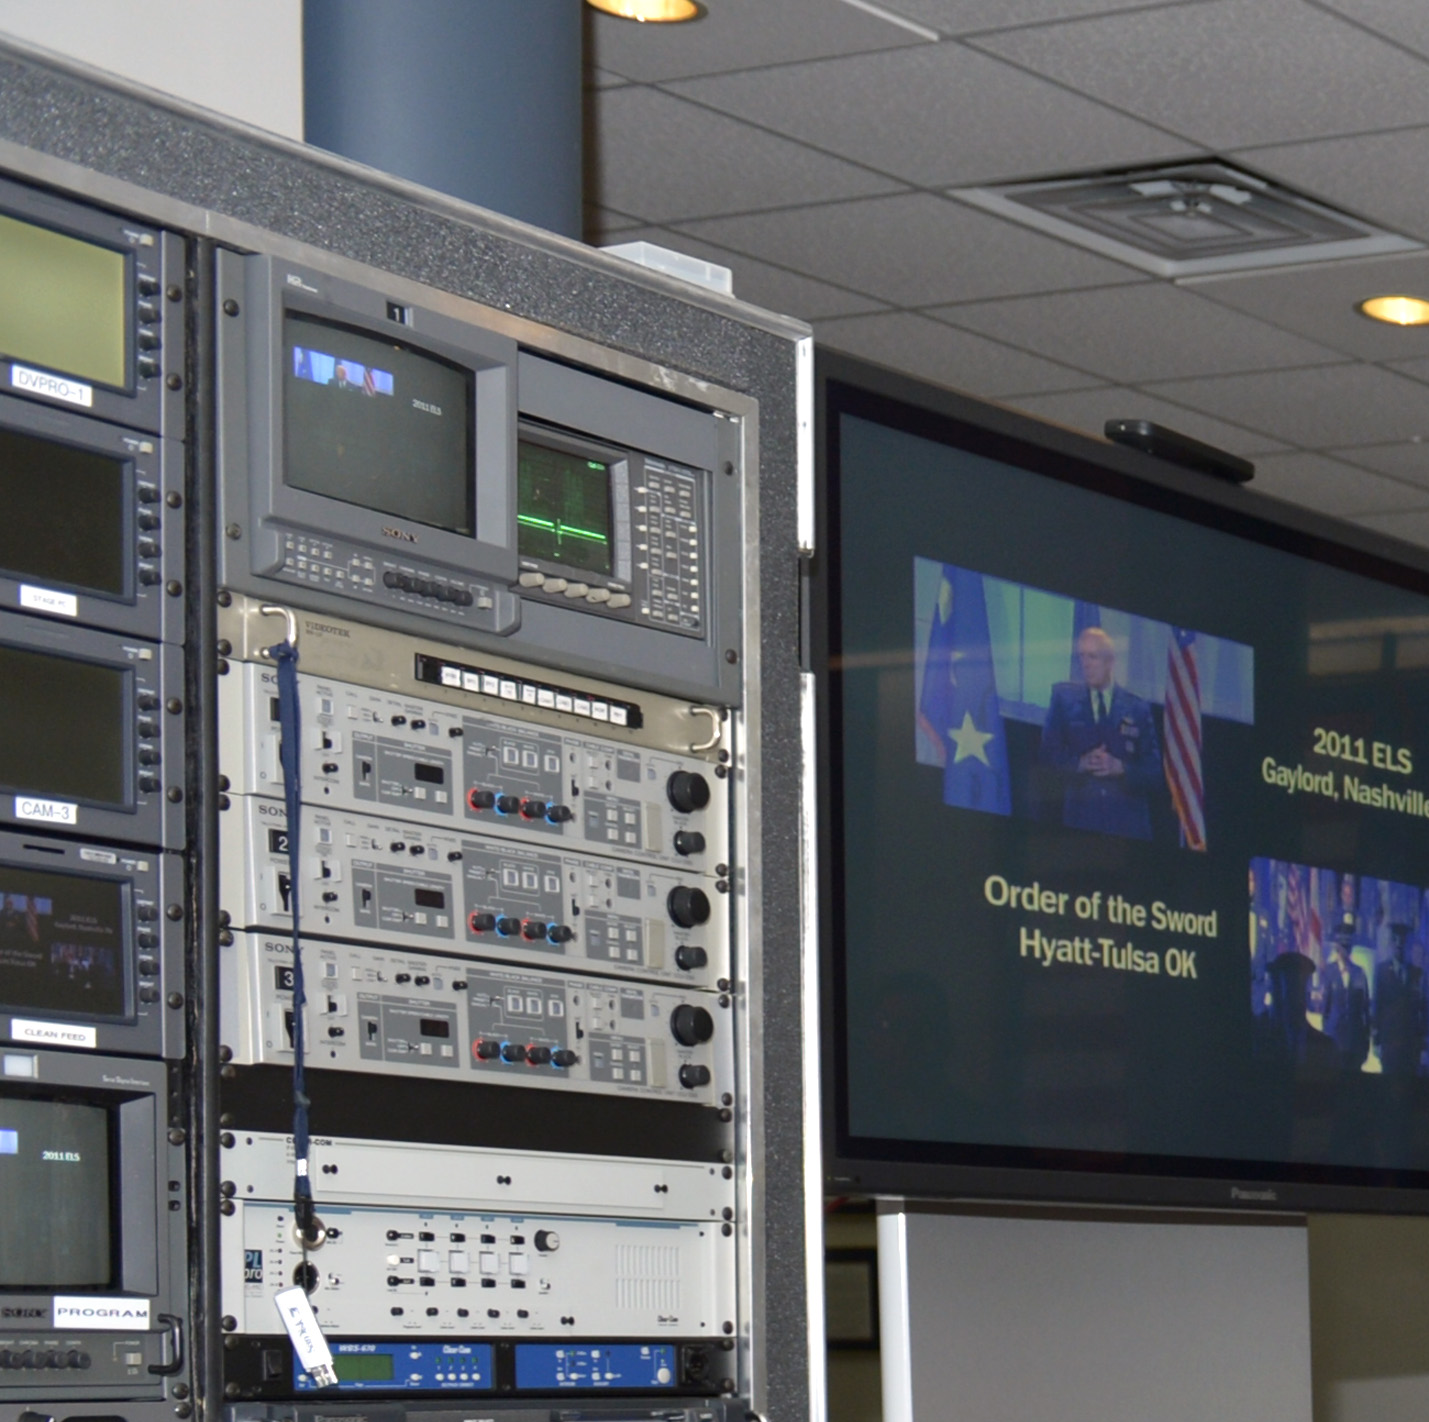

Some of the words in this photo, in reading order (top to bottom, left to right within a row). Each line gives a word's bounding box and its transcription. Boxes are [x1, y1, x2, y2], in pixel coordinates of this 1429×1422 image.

[392, 306, 400, 322] 1
[19, 369, 84, 401] DVPRO-1
[412, 399, 429, 412] 2011
[382, 526, 420, 544] SONY
[305, 621, 351, 638] VIDEOTEK
[1313, 727, 1370, 765] 2011
[1372, 738, 1413, 776] ELS
[1262, 756, 1341, 802] Gaylord,
[22, 801, 70, 821] CAM-3
[278, 836, 289, 851] 2
[984, 874, 1070, 917] Order
[1074, 891, 1102, 921] of
[1107, 896, 1148, 928] the
[1151, 901, 1219, 938] Sword
[1018, 926, 1161, 977] Hyatt-Tulsa
[1165, 947, 1198, 980] OK
[284, 971, 294, 987] 3
[24, 1028, 58, 1040] CLEAN
[61, 1031, 86, 1042] FEED
[42, 1151, 65, 1161] 2011
[1231, 1187, 1277, 1200] Panasonic
[245, 1251, 262, 1268] PL
[57, 1307, 149, 1318] PROGRAM
